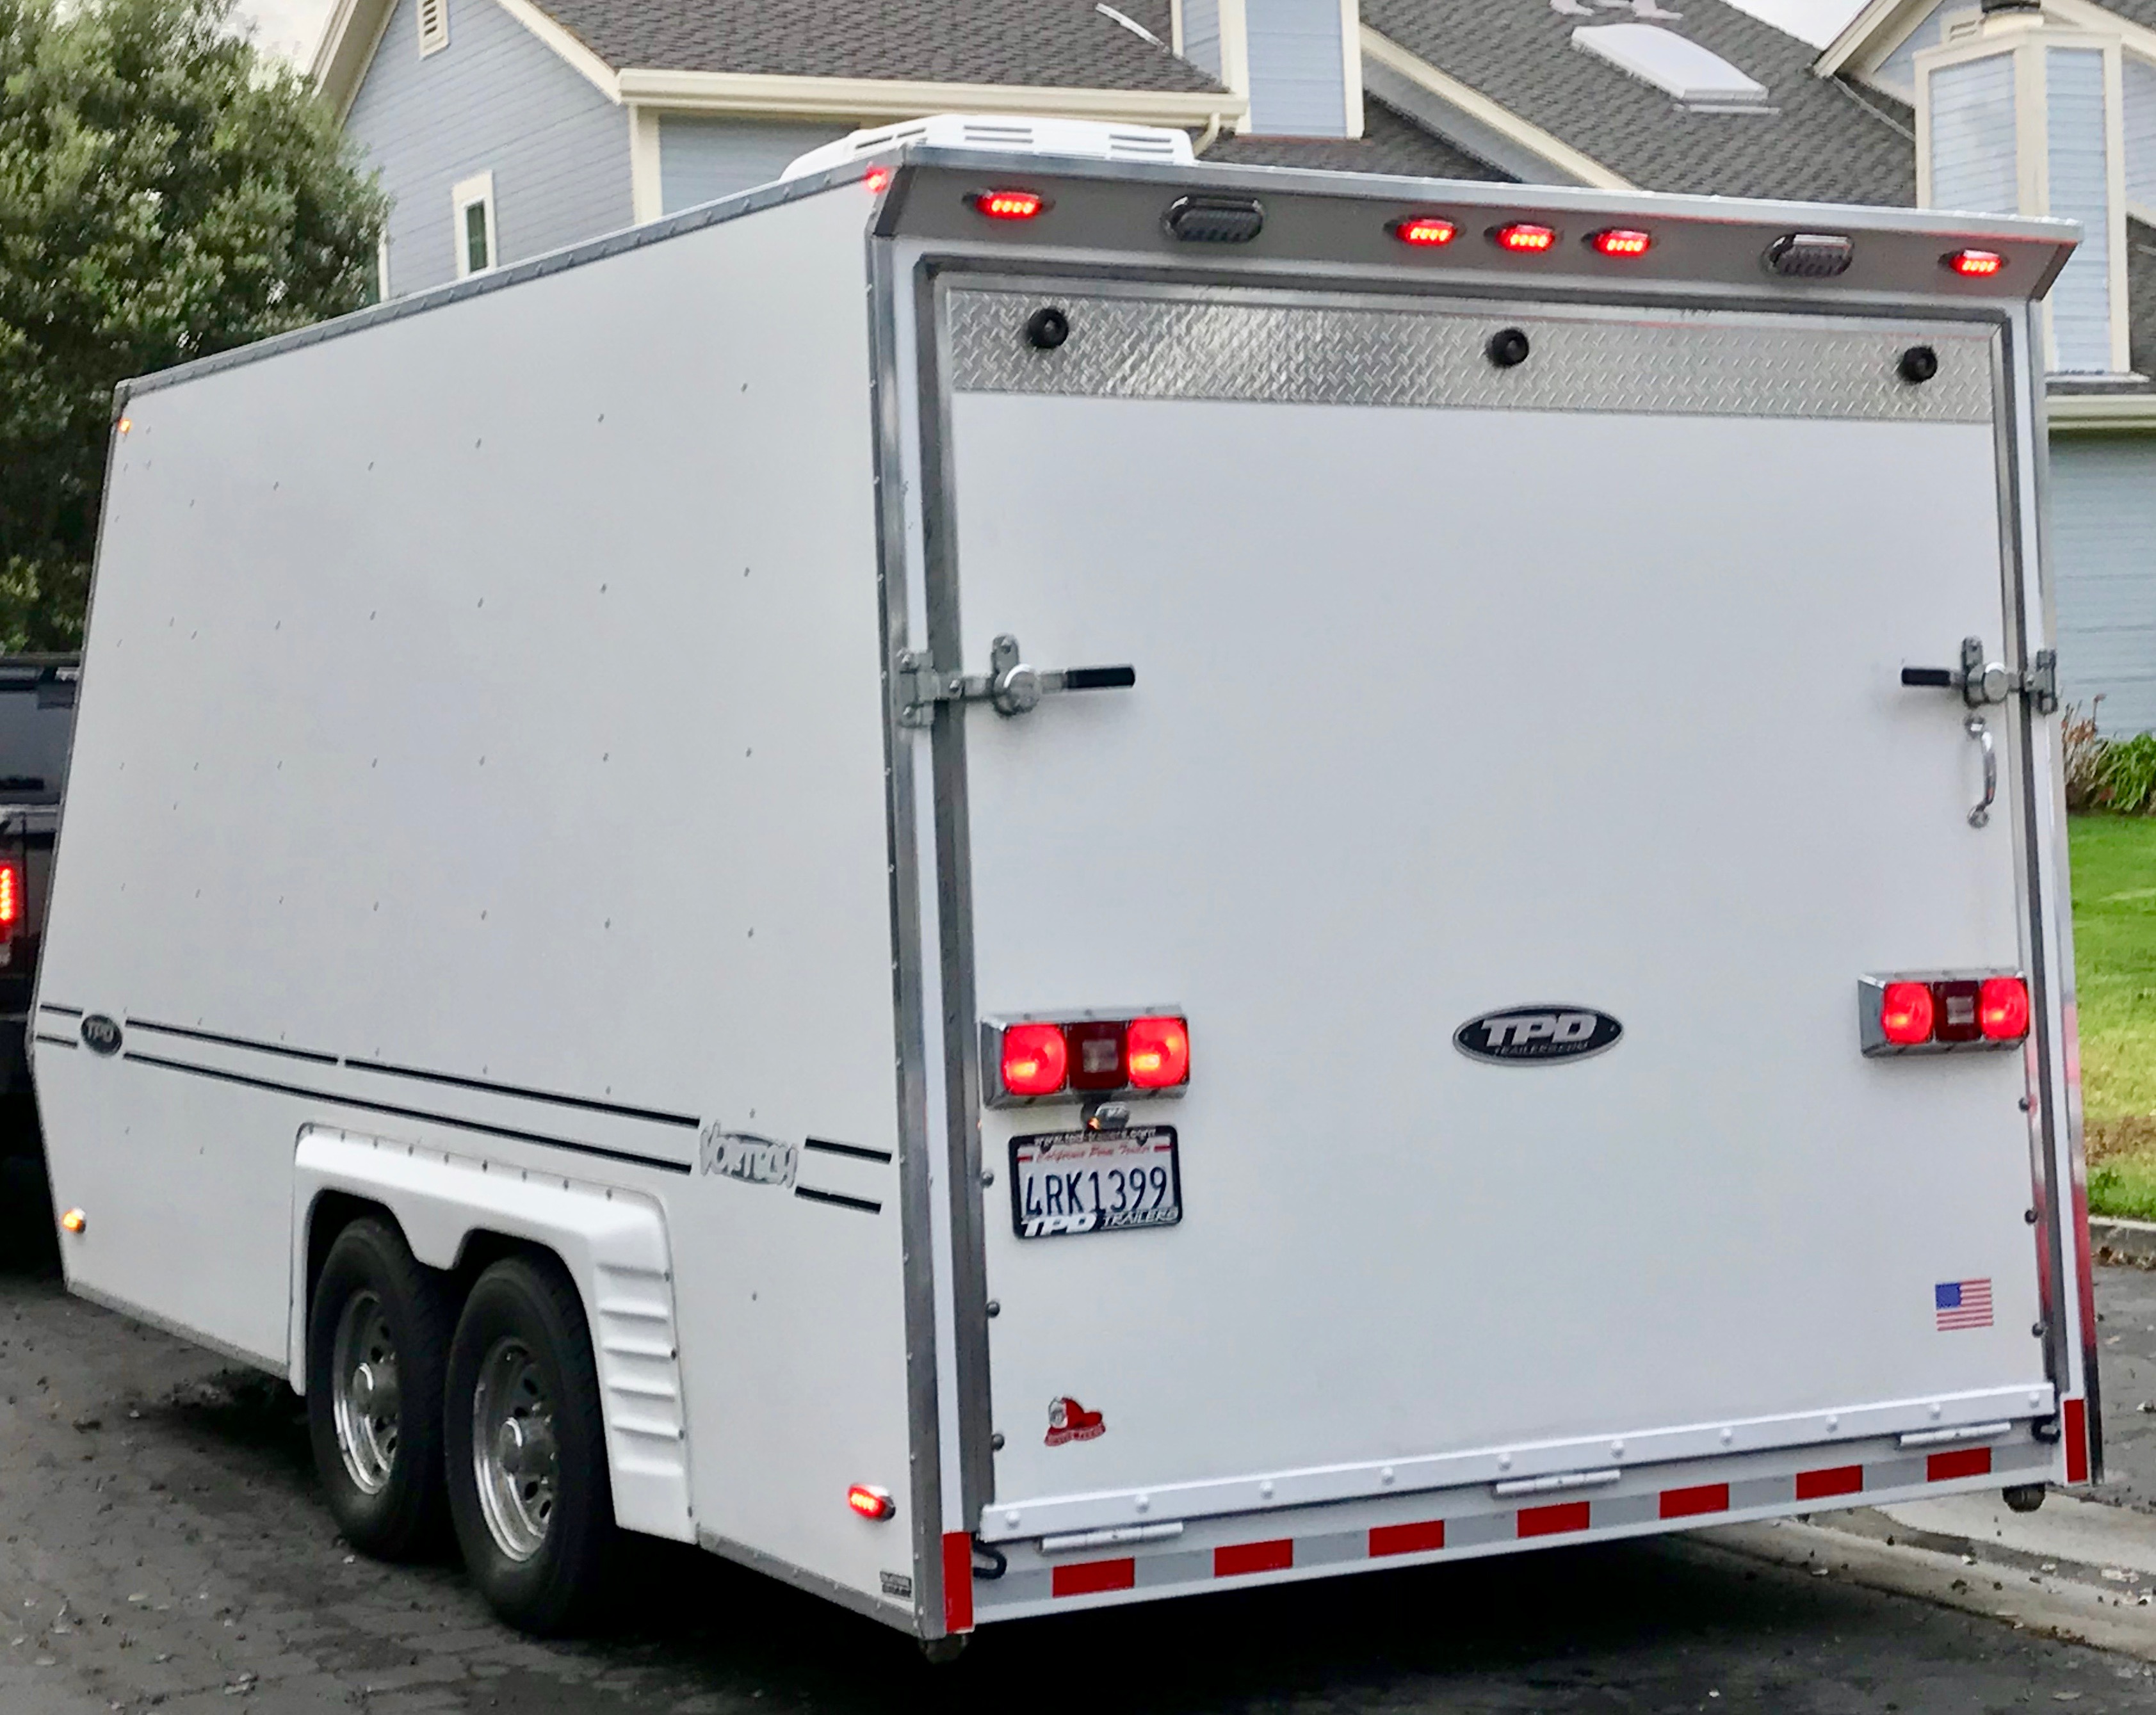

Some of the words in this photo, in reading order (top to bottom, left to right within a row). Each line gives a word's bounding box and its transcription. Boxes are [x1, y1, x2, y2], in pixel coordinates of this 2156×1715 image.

[86, 1019, 115, 1043] TPD
[1480, 1012, 1598, 1047] TPD
[1026, 1166, 1167, 1216] 4RK1399
[1021, 1212, 1098, 1237] TPD
